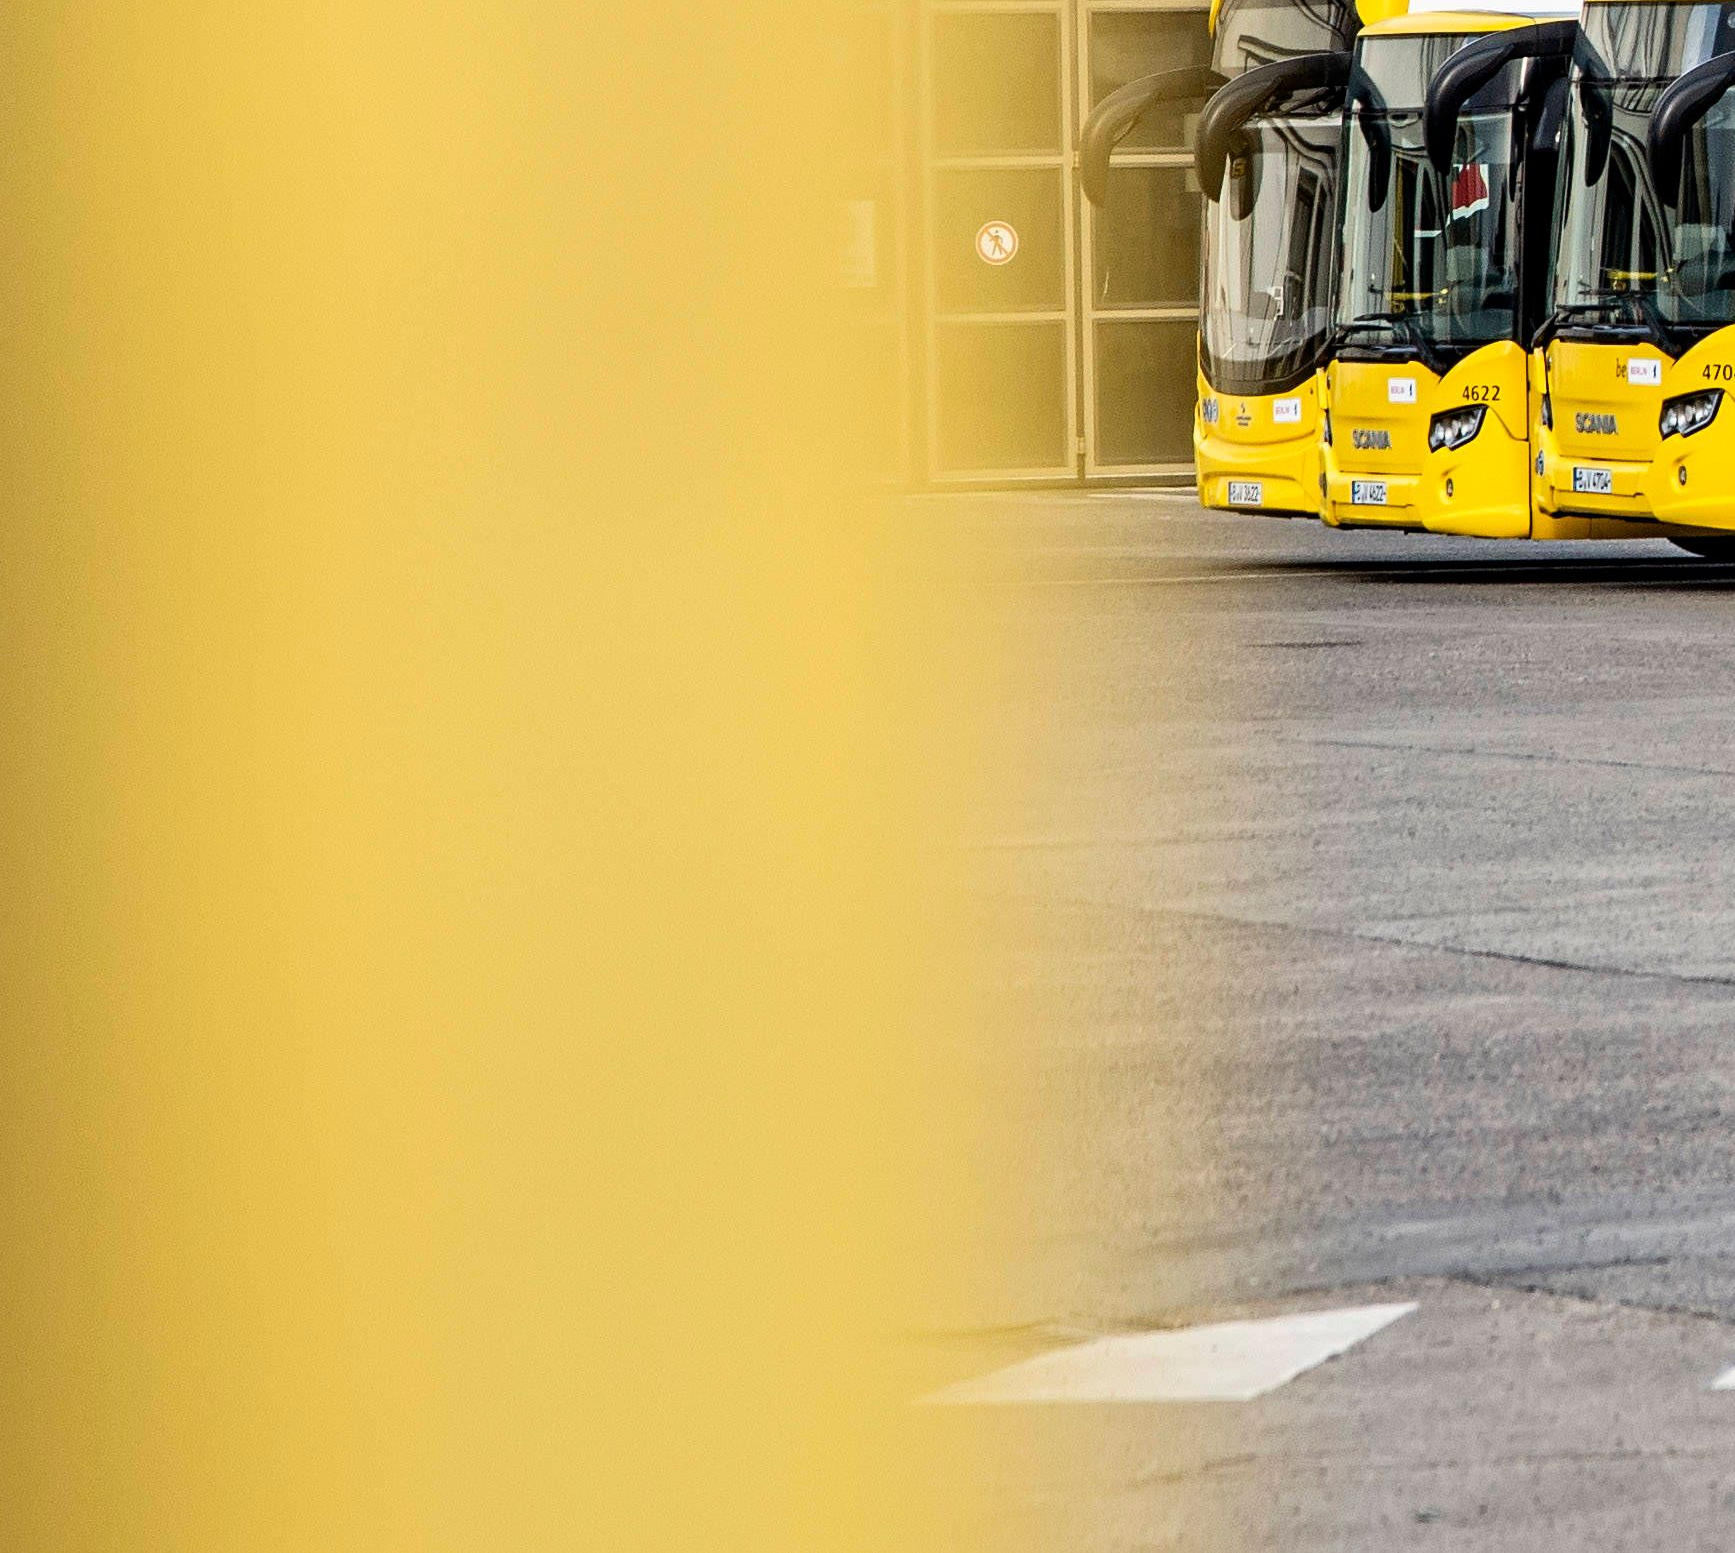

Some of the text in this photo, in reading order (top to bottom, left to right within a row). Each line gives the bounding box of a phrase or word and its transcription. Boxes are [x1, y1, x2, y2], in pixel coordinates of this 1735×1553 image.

[1462, 385, 1501, 402] 4622
[1575, 412, 1619, 435] SCANIA
[1352, 428, 1392, 450] SCANIA
